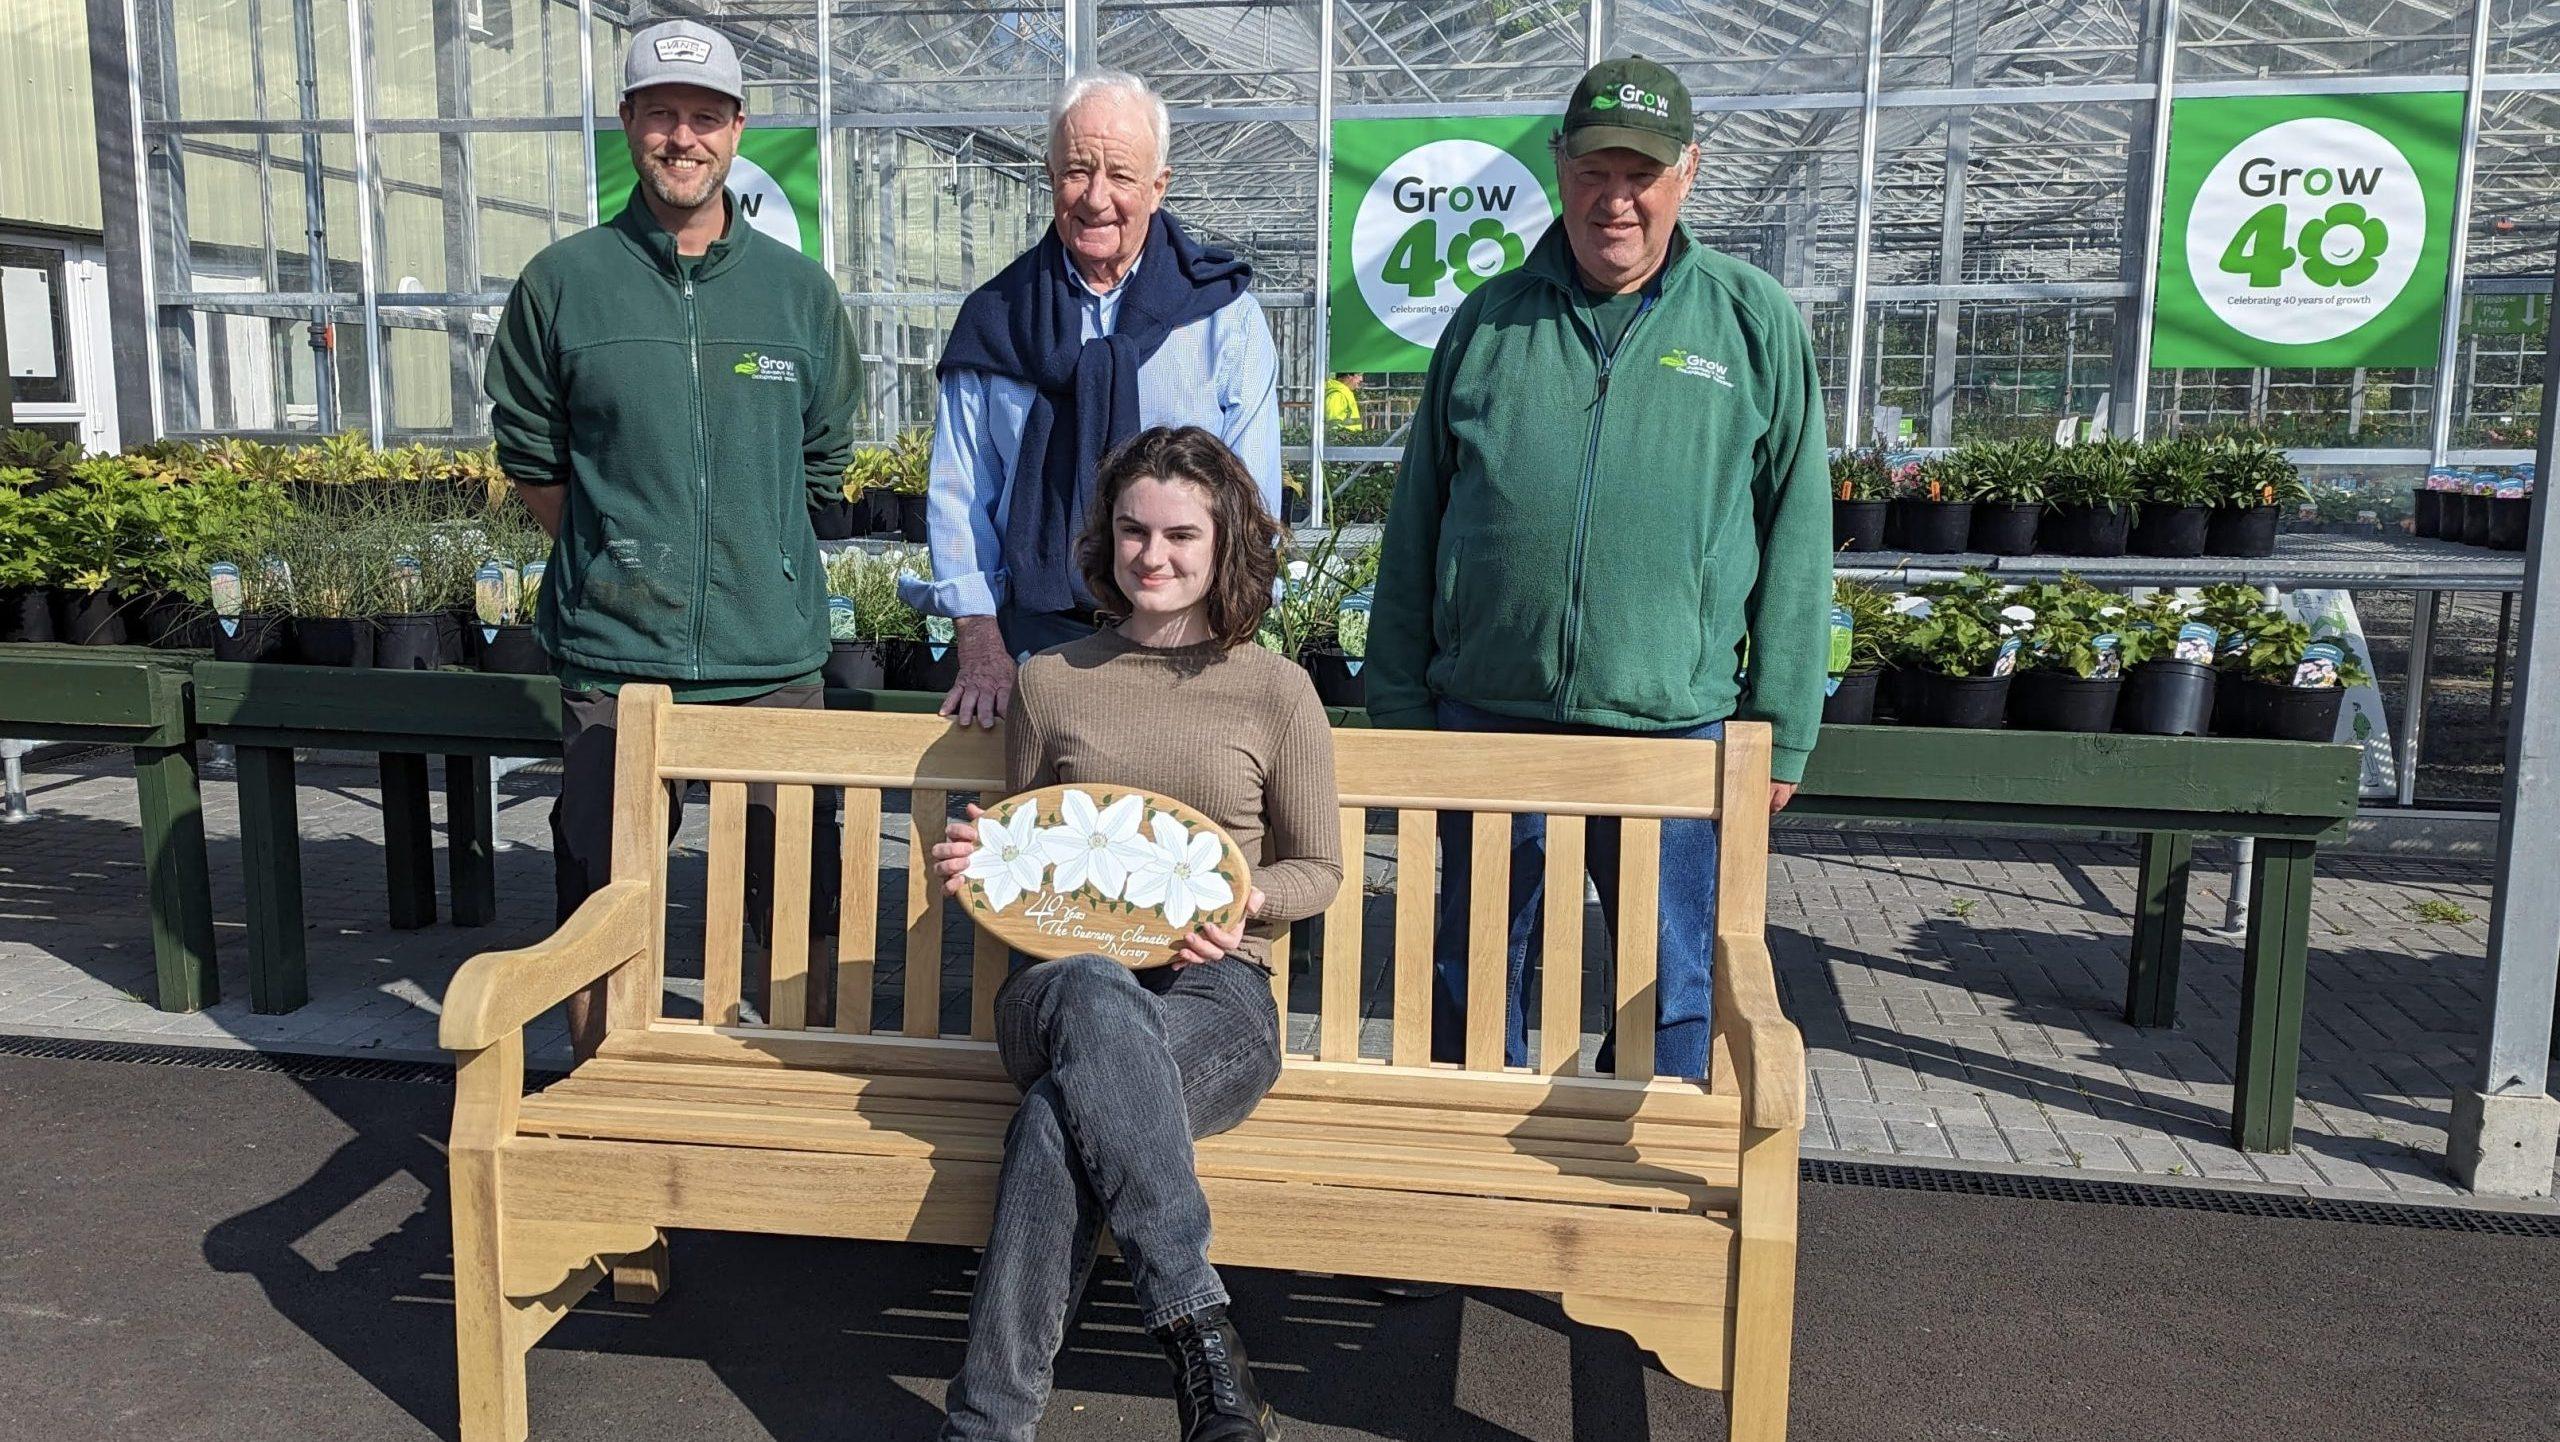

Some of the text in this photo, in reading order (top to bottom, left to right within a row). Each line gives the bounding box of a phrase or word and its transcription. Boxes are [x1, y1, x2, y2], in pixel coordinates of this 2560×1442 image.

[1619, 83, 1669, 110] Grow
[2238, 157, 2383, 197] Grow
[1392, 176, 1516, 214] Grow
[1390, 305, 1437, 315] Celebrating
[1438, 305, 1450, 313] 40
[2227, 295, 2371, 307] Celebrating 40 years of growth
[2483, 306, 2507, 318] Pay
[2478, 319, 2510, 328] Here
[758, 355, 794, 371] Grow
[1686, 355, 1728, 375] Grow
[1024, 891, 1064, 926] 40
[1039, 919, 1171, 949] The Guernsey Clematis
[1108, 942, 1151, 966] Nursery
